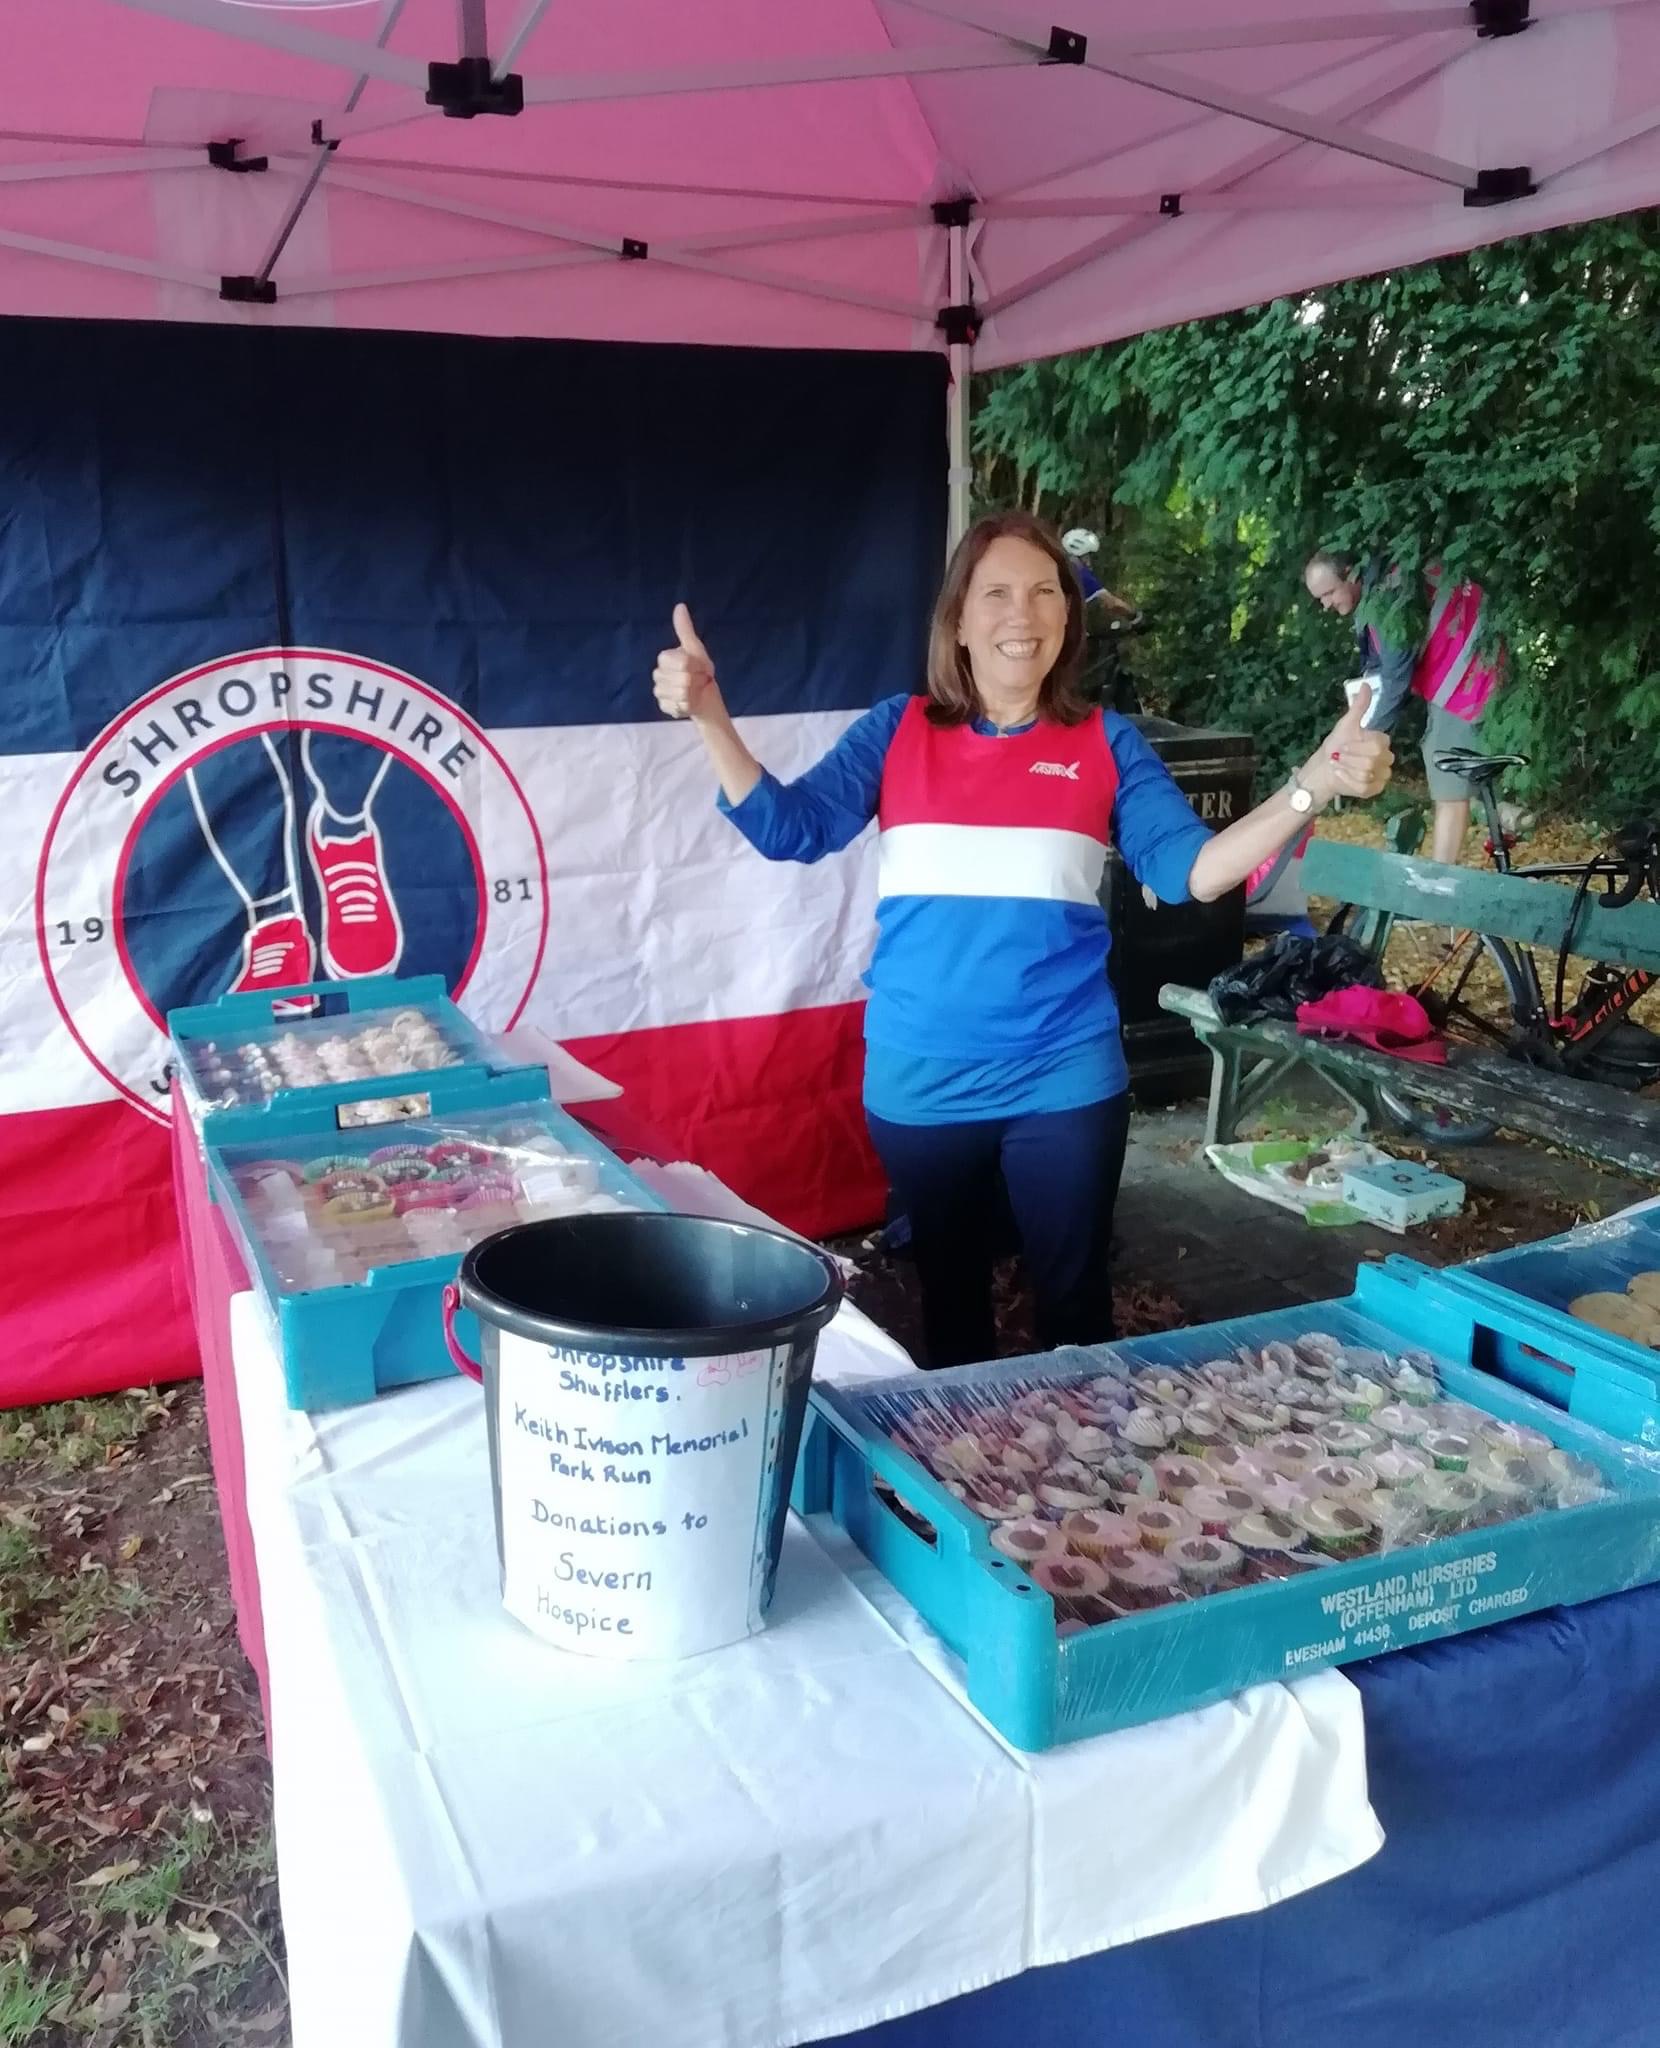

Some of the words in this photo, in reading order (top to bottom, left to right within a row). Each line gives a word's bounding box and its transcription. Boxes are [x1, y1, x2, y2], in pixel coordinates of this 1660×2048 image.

[103, 671, 477, 798] SHROPSHIRE
[1185, 790, 1233, 819] TER
[493, 877, 534, 903] 81
[56, 916, 105, 945] 19
[515, 1401, 568, 1445] Keith
[652, 1417, 748, 1456] Memorial
[550, 1453, 595, 1481] Park
[604, 1465, 652, 1484] Run
[531, 1498, 667, 1536] Donations
[681, 1512, 708, 1530] to
[554, 1552, 652, 1591] Severn
[1321, 1575, 1407, 1614] WESTLAND
[1412, 1551, 1497, 1588] NURSERIES
[537, 1584, 633, 1635] Hospice
[1340, 1586, 1434, 1631] (OFFENHAM)
[1450, 1576, 1478, 1600] LTD
[1285, 1635, 1346, 1666] EVESHAM
[1409, 1604, 1462, 1632] DEPOSIT
[1468, 1587, 1528, 1616] CHARGED
